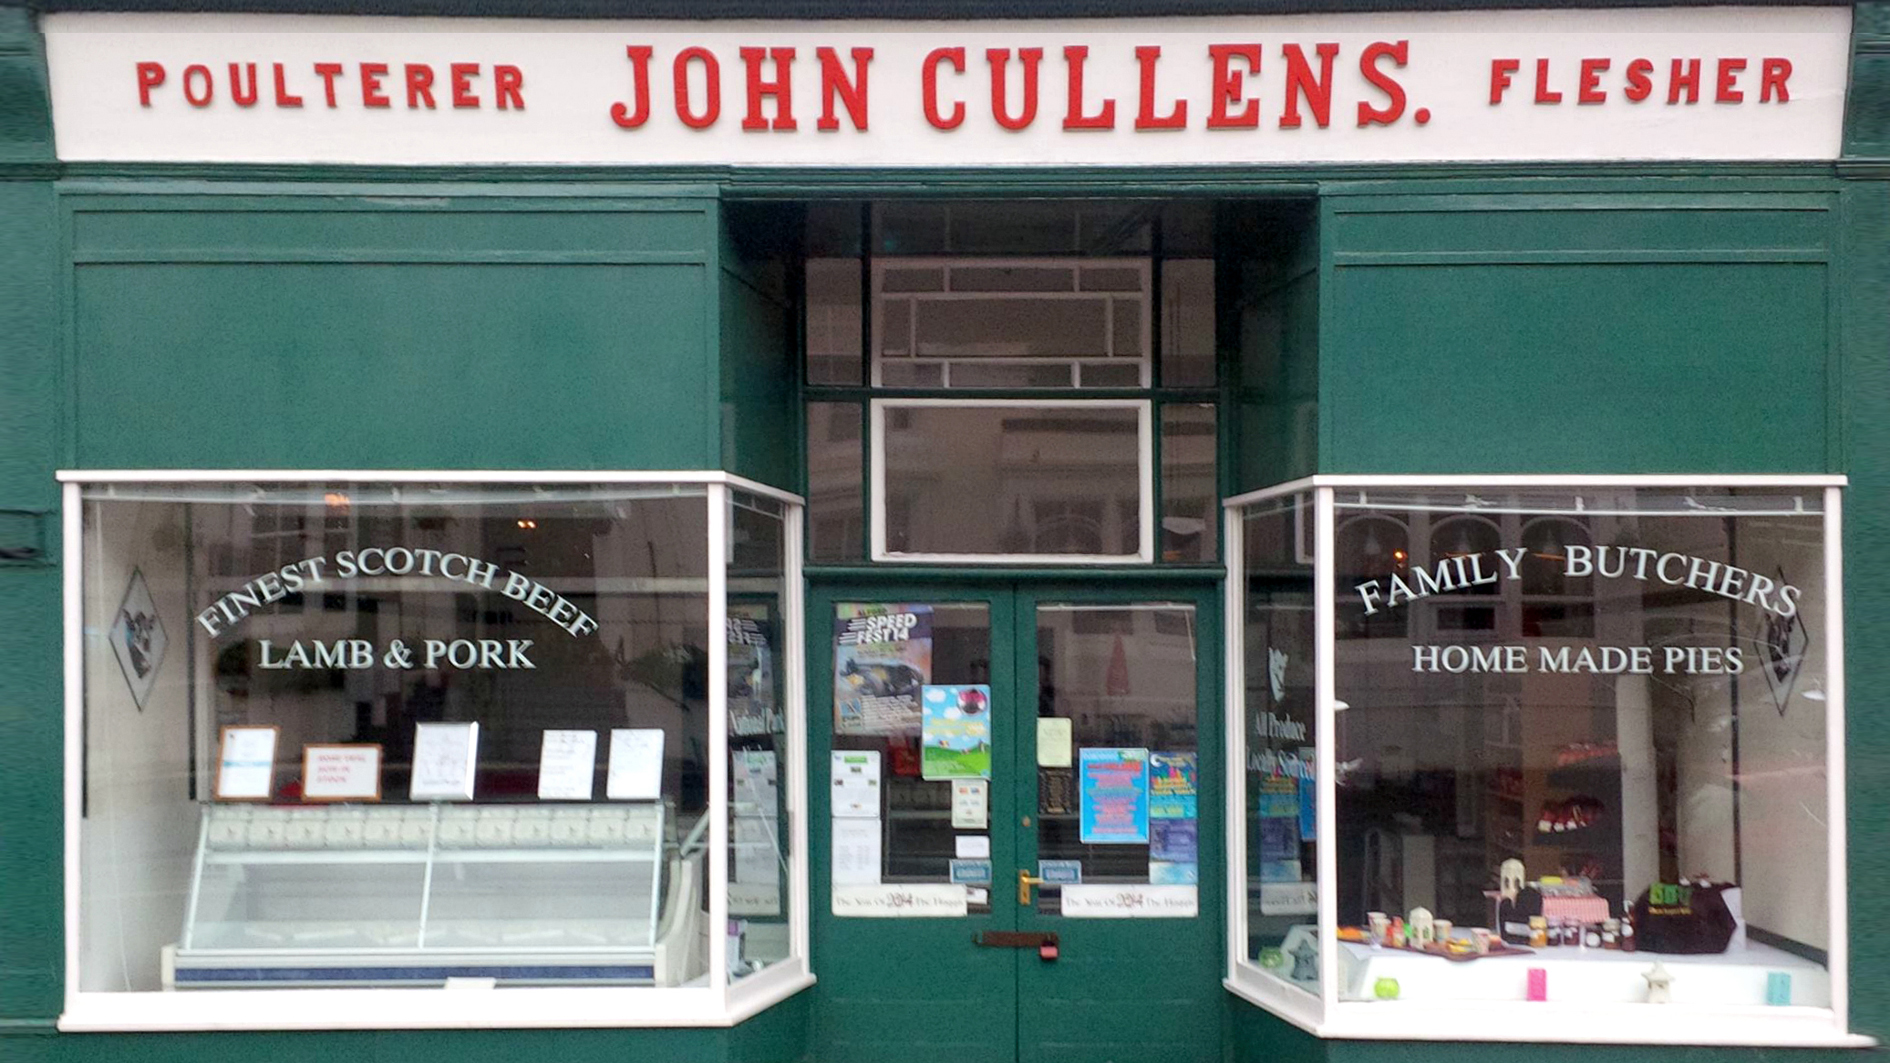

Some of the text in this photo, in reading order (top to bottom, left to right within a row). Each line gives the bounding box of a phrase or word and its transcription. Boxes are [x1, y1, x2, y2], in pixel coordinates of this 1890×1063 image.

[136, 62, 525, 109] POULTERER
[610, 44, 875, 131] JOHN
[1489, 57, 1793, 105] FLESHER
[196, 546, 599, 638] FINEST SCOTCH BEEF
[1356, 544, 1802, 618] FAMILY BUTCHERS
[866, 612, 918, 630] SPEED
[259, 639, 535, 669] LAMB & PORK
[1412, 645, 1743, 673] HOME MADE PIES
